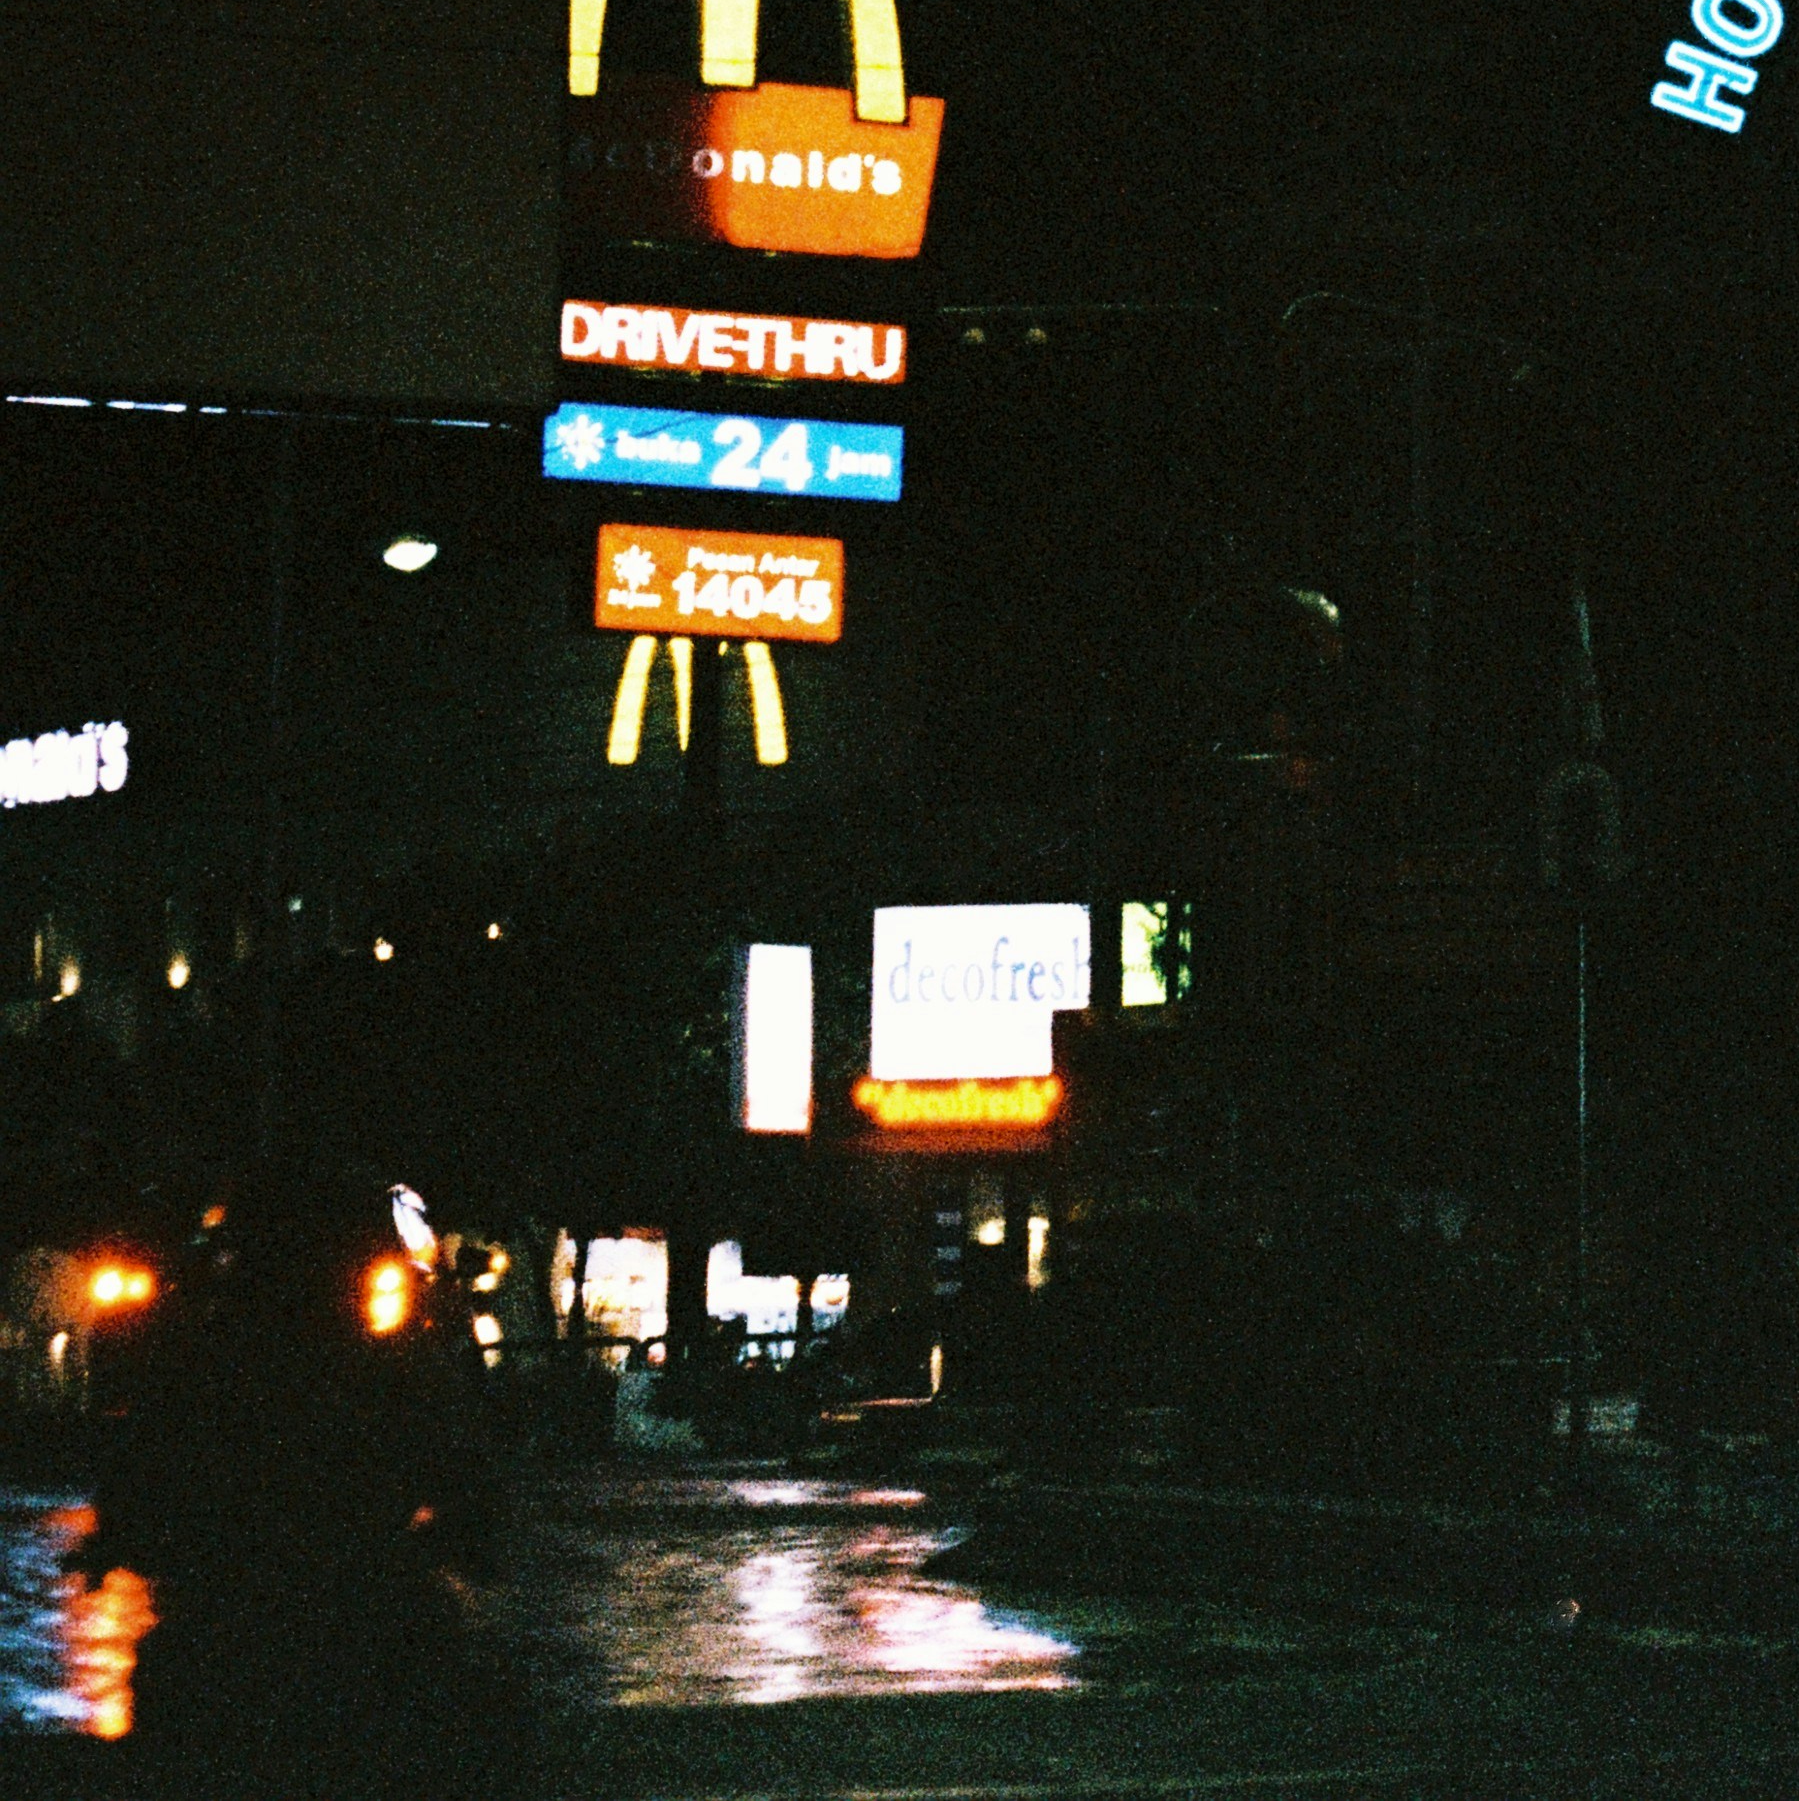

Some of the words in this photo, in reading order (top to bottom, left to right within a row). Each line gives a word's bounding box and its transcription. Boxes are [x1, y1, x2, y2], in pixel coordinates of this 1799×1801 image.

[710, 418, 814, 492] 24
[672, 570, 832, 624] 14045
[888, 935, 1090, 1004] decofresh
